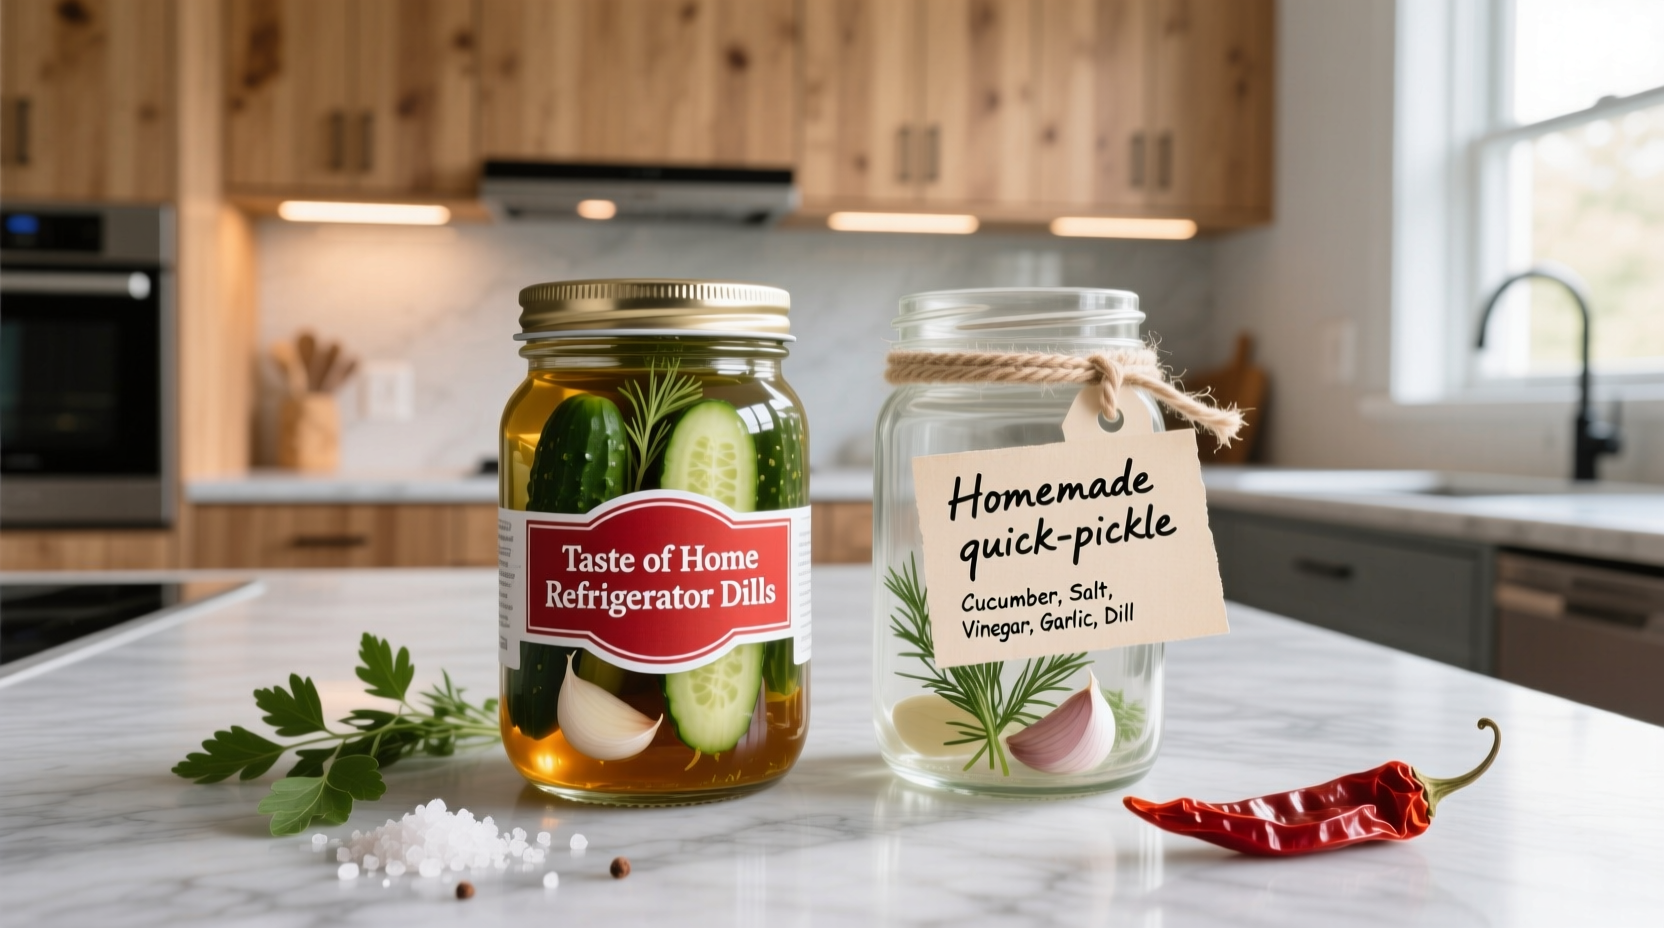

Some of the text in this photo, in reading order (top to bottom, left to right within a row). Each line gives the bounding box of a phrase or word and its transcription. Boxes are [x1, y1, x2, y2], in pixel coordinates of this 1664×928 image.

[948, 457, 1154, 521] Homemade
[562, 544, 759, 573] Taste of Home
[959, 503, 1177, 582] quick-pickle
[545, 576, 776, 618] Refrigerator Dills
[961, 581, 1113, 612] Cucumber, Salt,
[962, 602, 1134, 642] Vinegar, Garlic, Dill
